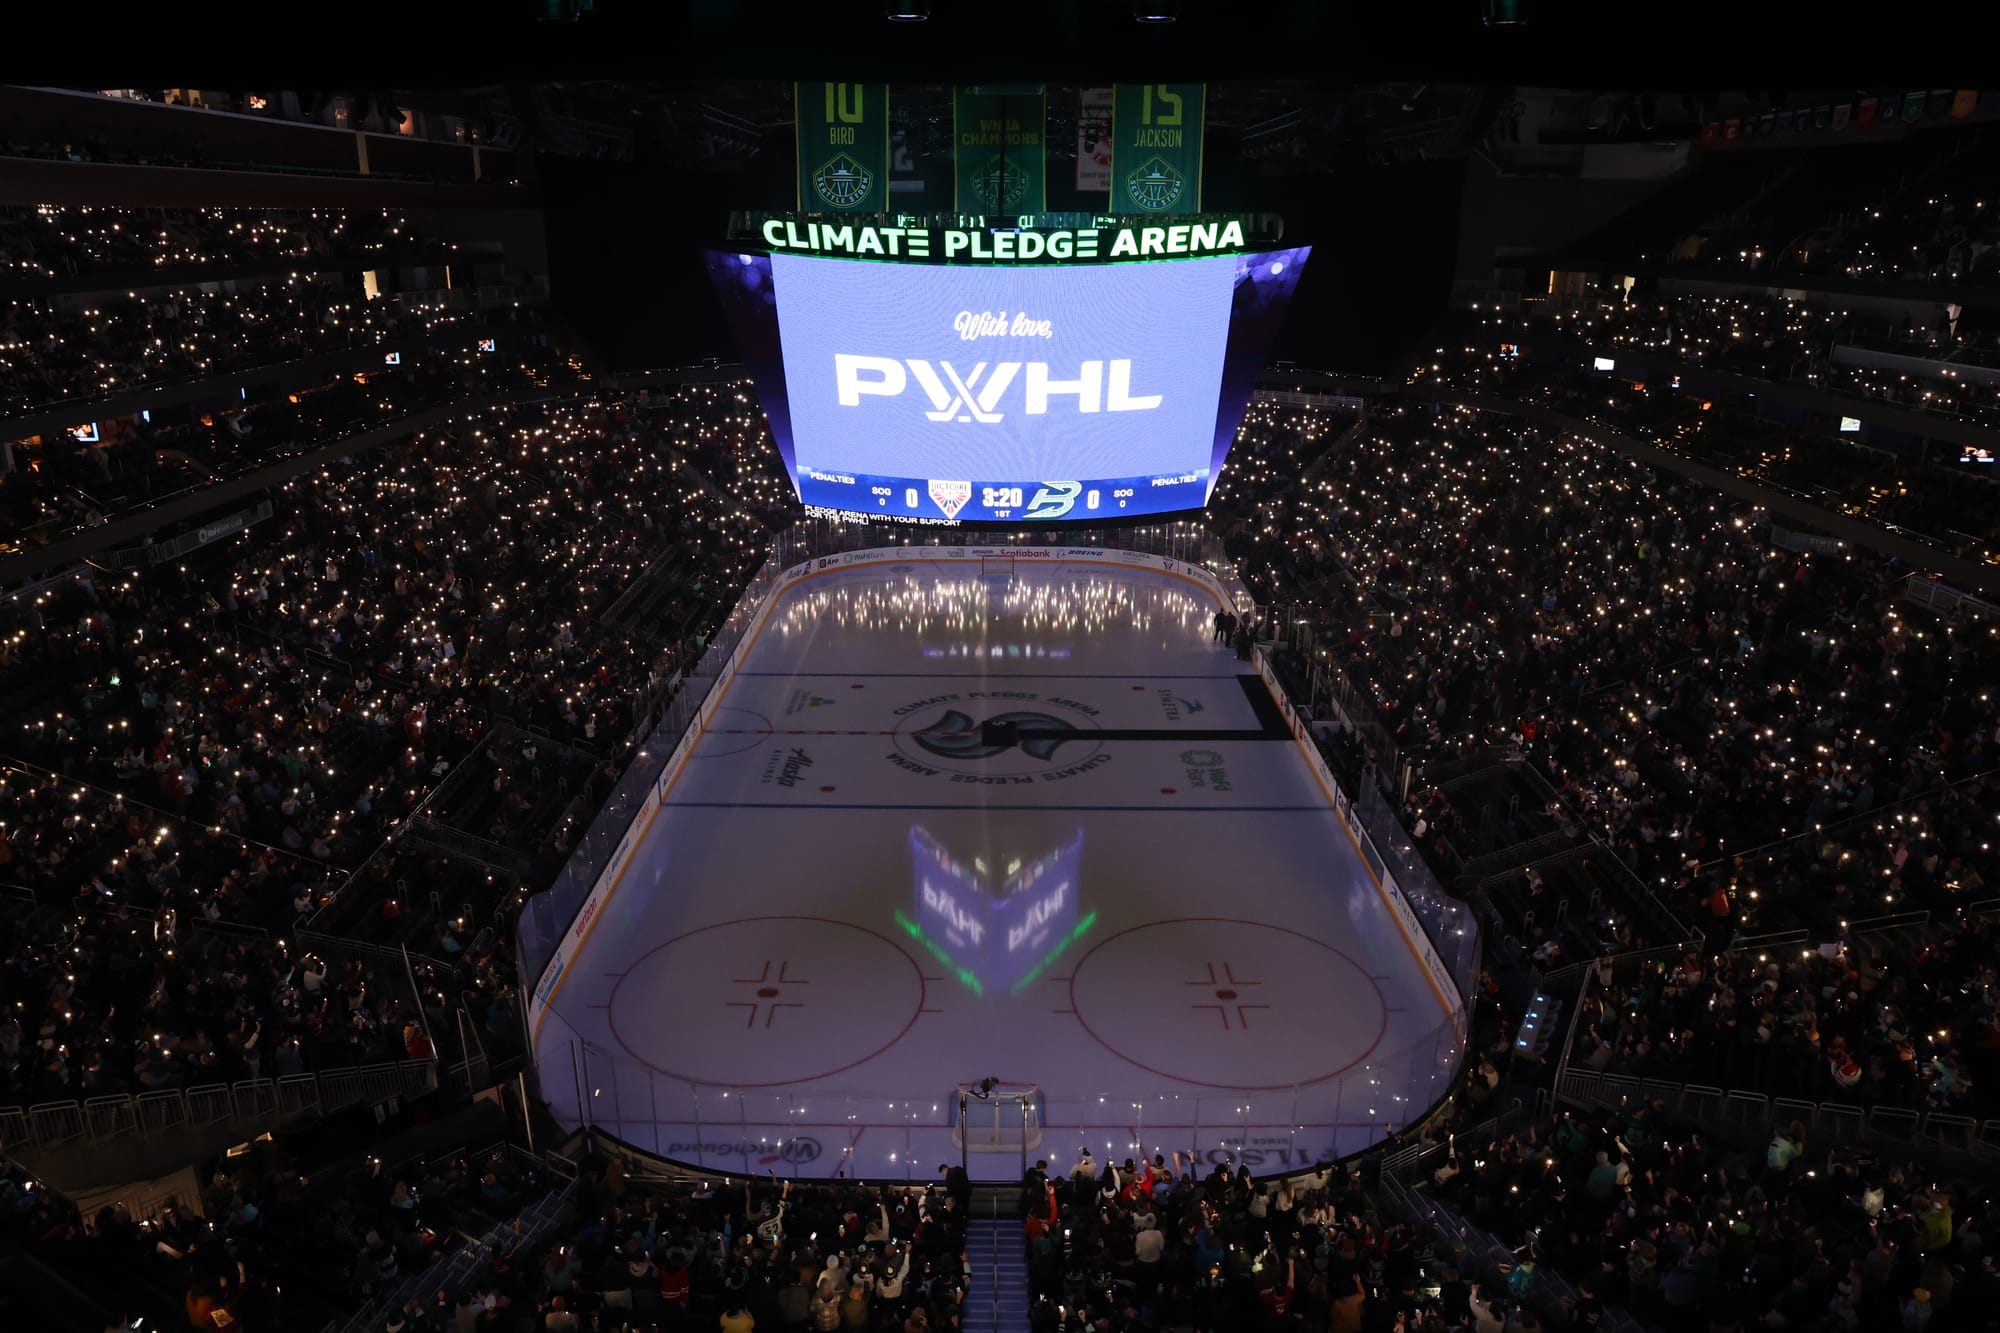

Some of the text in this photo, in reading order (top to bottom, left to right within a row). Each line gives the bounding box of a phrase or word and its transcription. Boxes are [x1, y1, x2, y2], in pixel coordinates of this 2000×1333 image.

[829, 127, 855, 145] BIRD
[1133, 129, 1183, 148] JACKSON
[815, 175, 869, 205] SEATTLE STORM
[1129, 179, 1183, 208] SEATTLE STORM
[762, 219, 930, 257] CLIMATE
[944, 229, 1099, 259] PLEDGE
[1109, 220, 1245, 257] ARENA
[954, 311, 1053, 341] With love,
[834, 353, 1164, 423] PWHL
[810, 472, 856, 485] PENALTIES
[1151, 475, 1198, 487] PENALTIES
[871, 486, 892, 496] SOG
[906, 488, 918, 508] 0
[982, 488, 1023, 508] 3:20
[1087, 490, 1100, 509] 0
[1113, 489, 1134, 498] SOG
[878, 498, 886, 506] 0
[1119, 500, 1126, 508] 0
[804, 505, 962, 527] PLEDGE ARENA WITH YOUR SUPPORT
[805, 511, 824, 519] FOR
[994, 510, 1011, 518] 1ST
[1001, 548, 1051, 558] Scotiabank
[1067, 549, 1104, 557] BOEING
[893, 691, 1101, 717] CLIMATE PLEDGE ARENA
[776, 748, 813, 787] Alaska
[885, 752, 1113, 785] CLIMATE PLEDGE ARENA
[575, 898, 598, 938] verizon
[669, 1138, 817, 1162] WatchGuard
